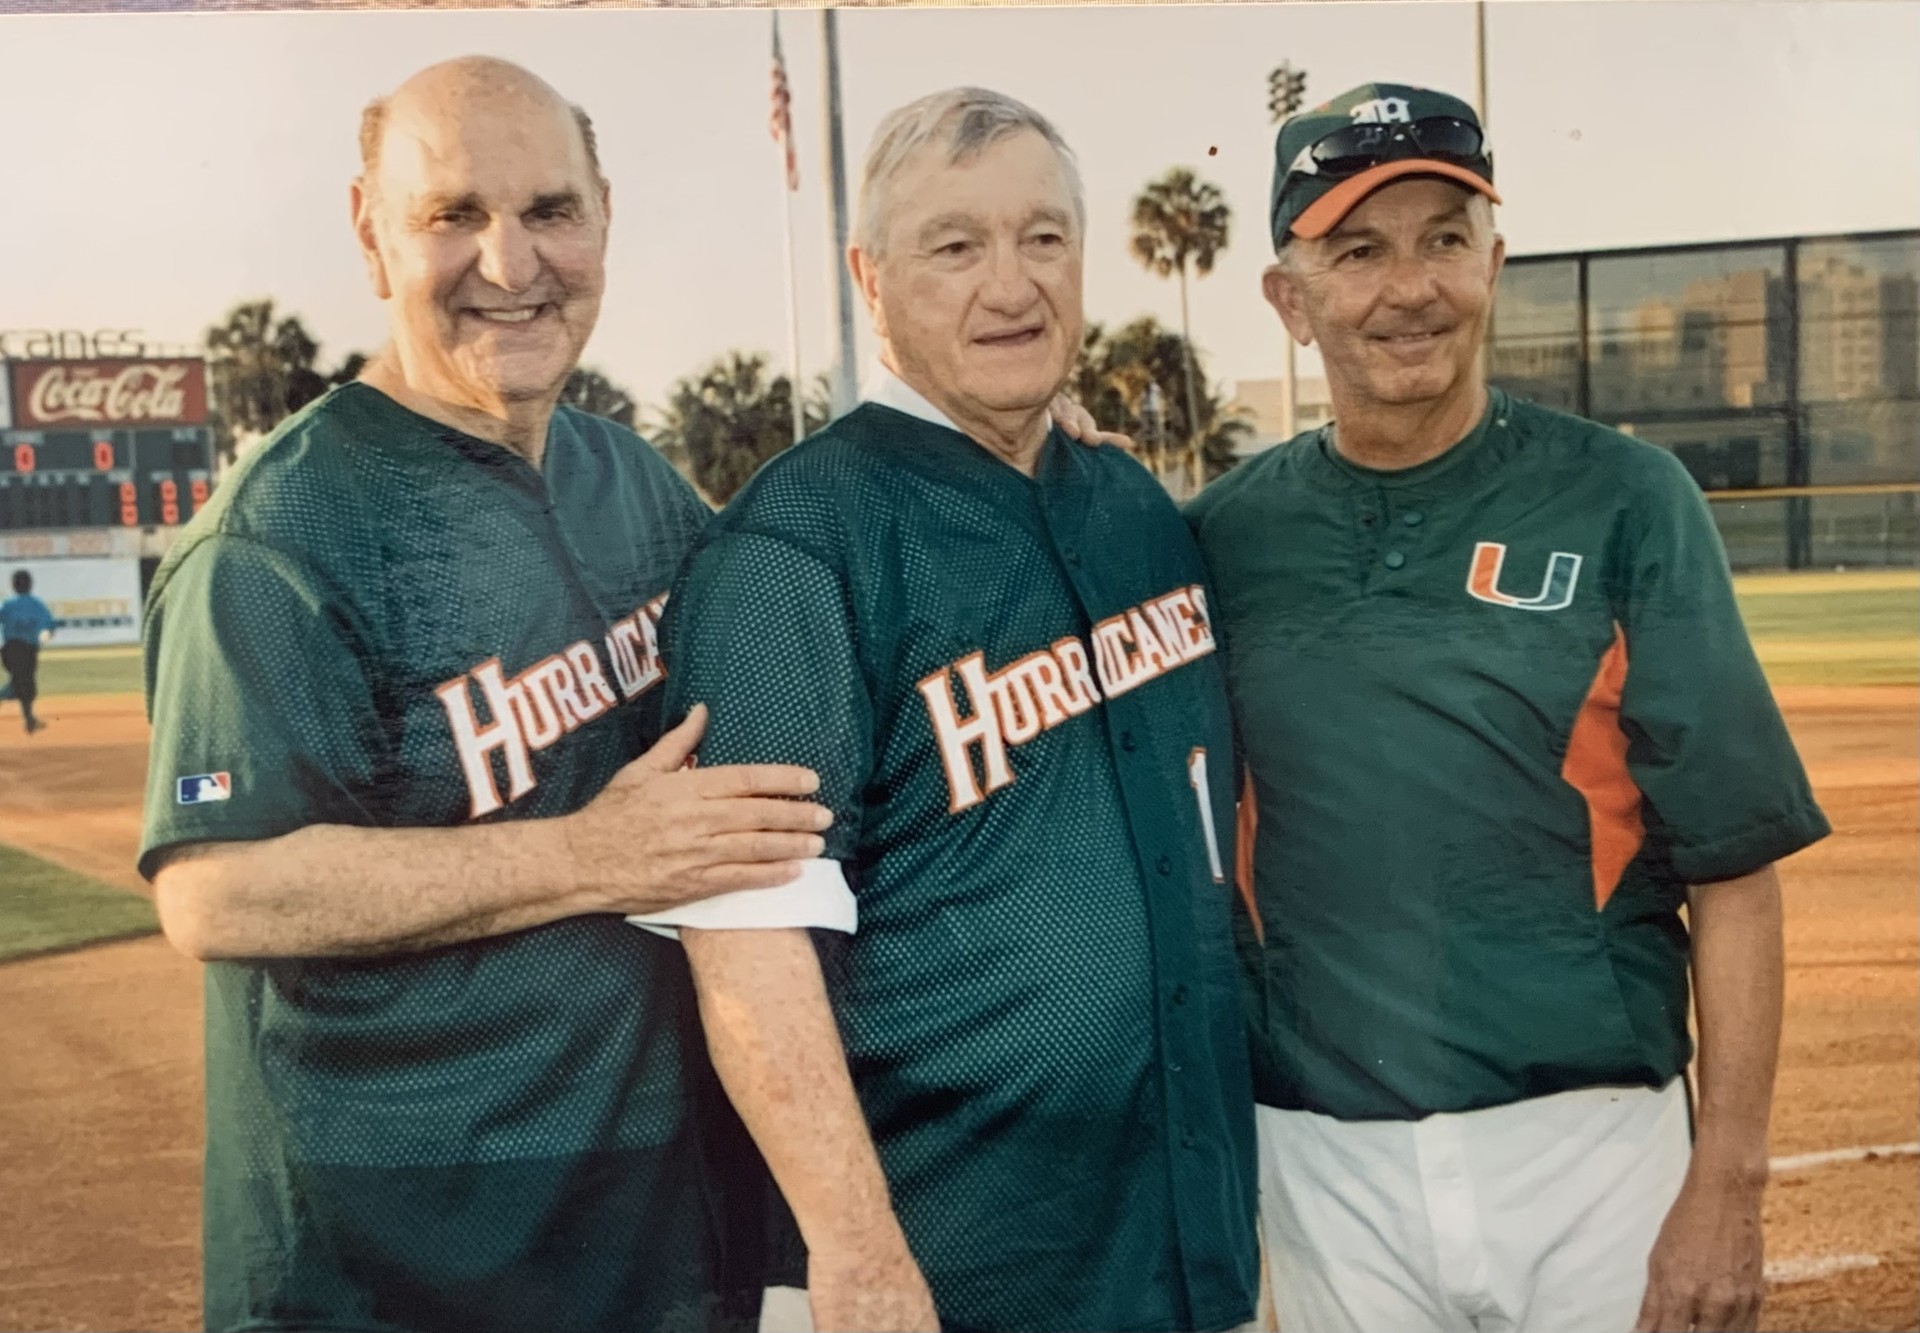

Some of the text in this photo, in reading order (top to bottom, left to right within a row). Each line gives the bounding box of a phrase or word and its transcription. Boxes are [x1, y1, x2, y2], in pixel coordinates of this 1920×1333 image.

[29, 364, 188, 423] Coca-Cola
[1466, 541, 1583, 611] U
[1188, 746, 1225, 884] 1
